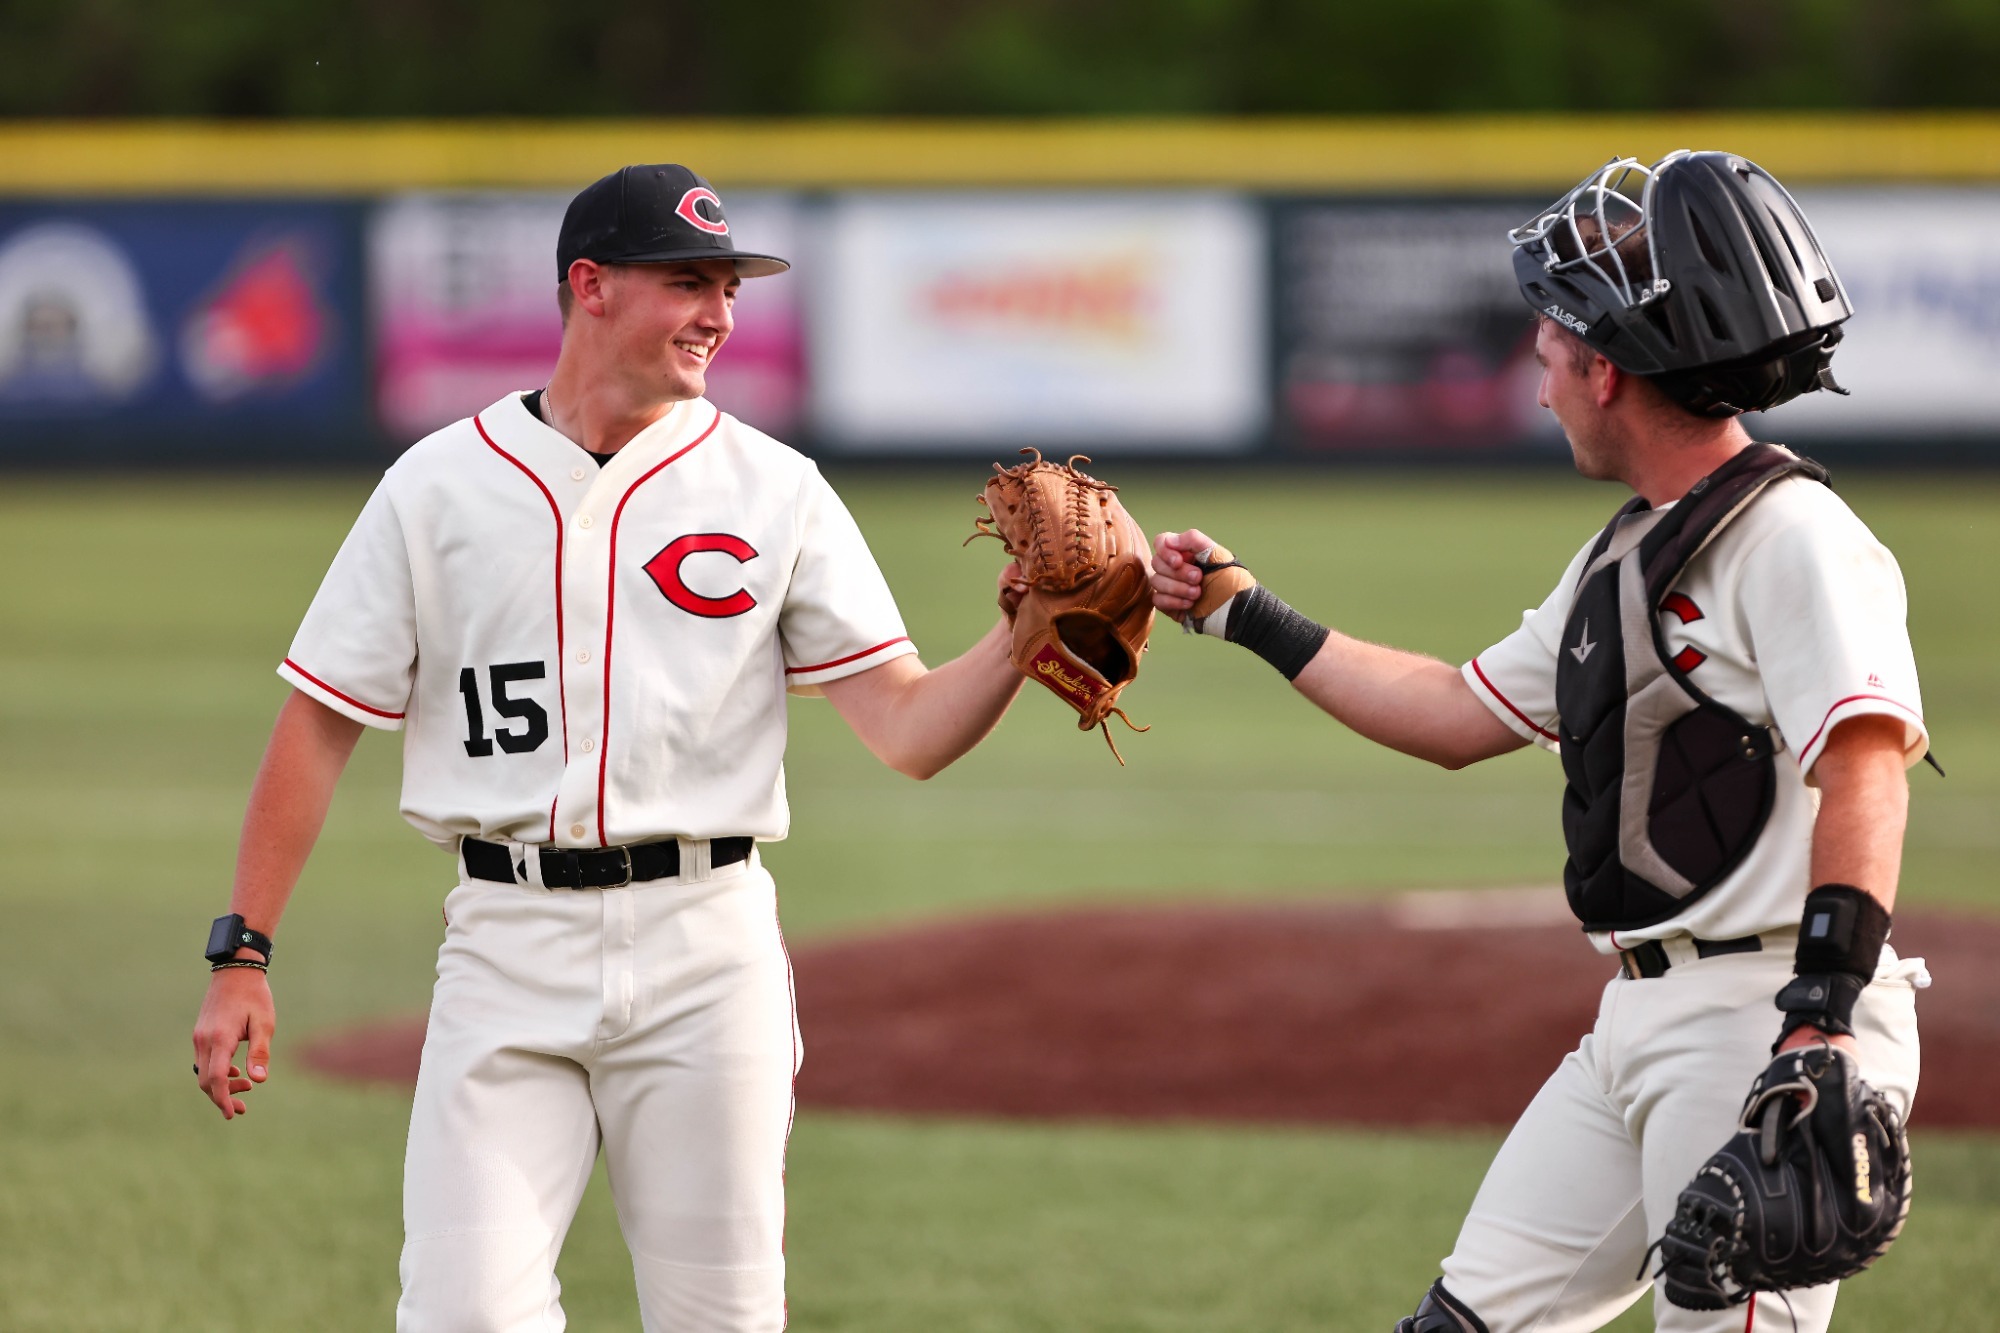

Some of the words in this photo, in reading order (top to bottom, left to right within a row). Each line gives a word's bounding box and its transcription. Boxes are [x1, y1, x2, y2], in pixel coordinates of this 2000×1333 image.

[675, 187, 729, 236] C
[641, 533, 759, 618] C
[459, 661, 549, 757] 15
